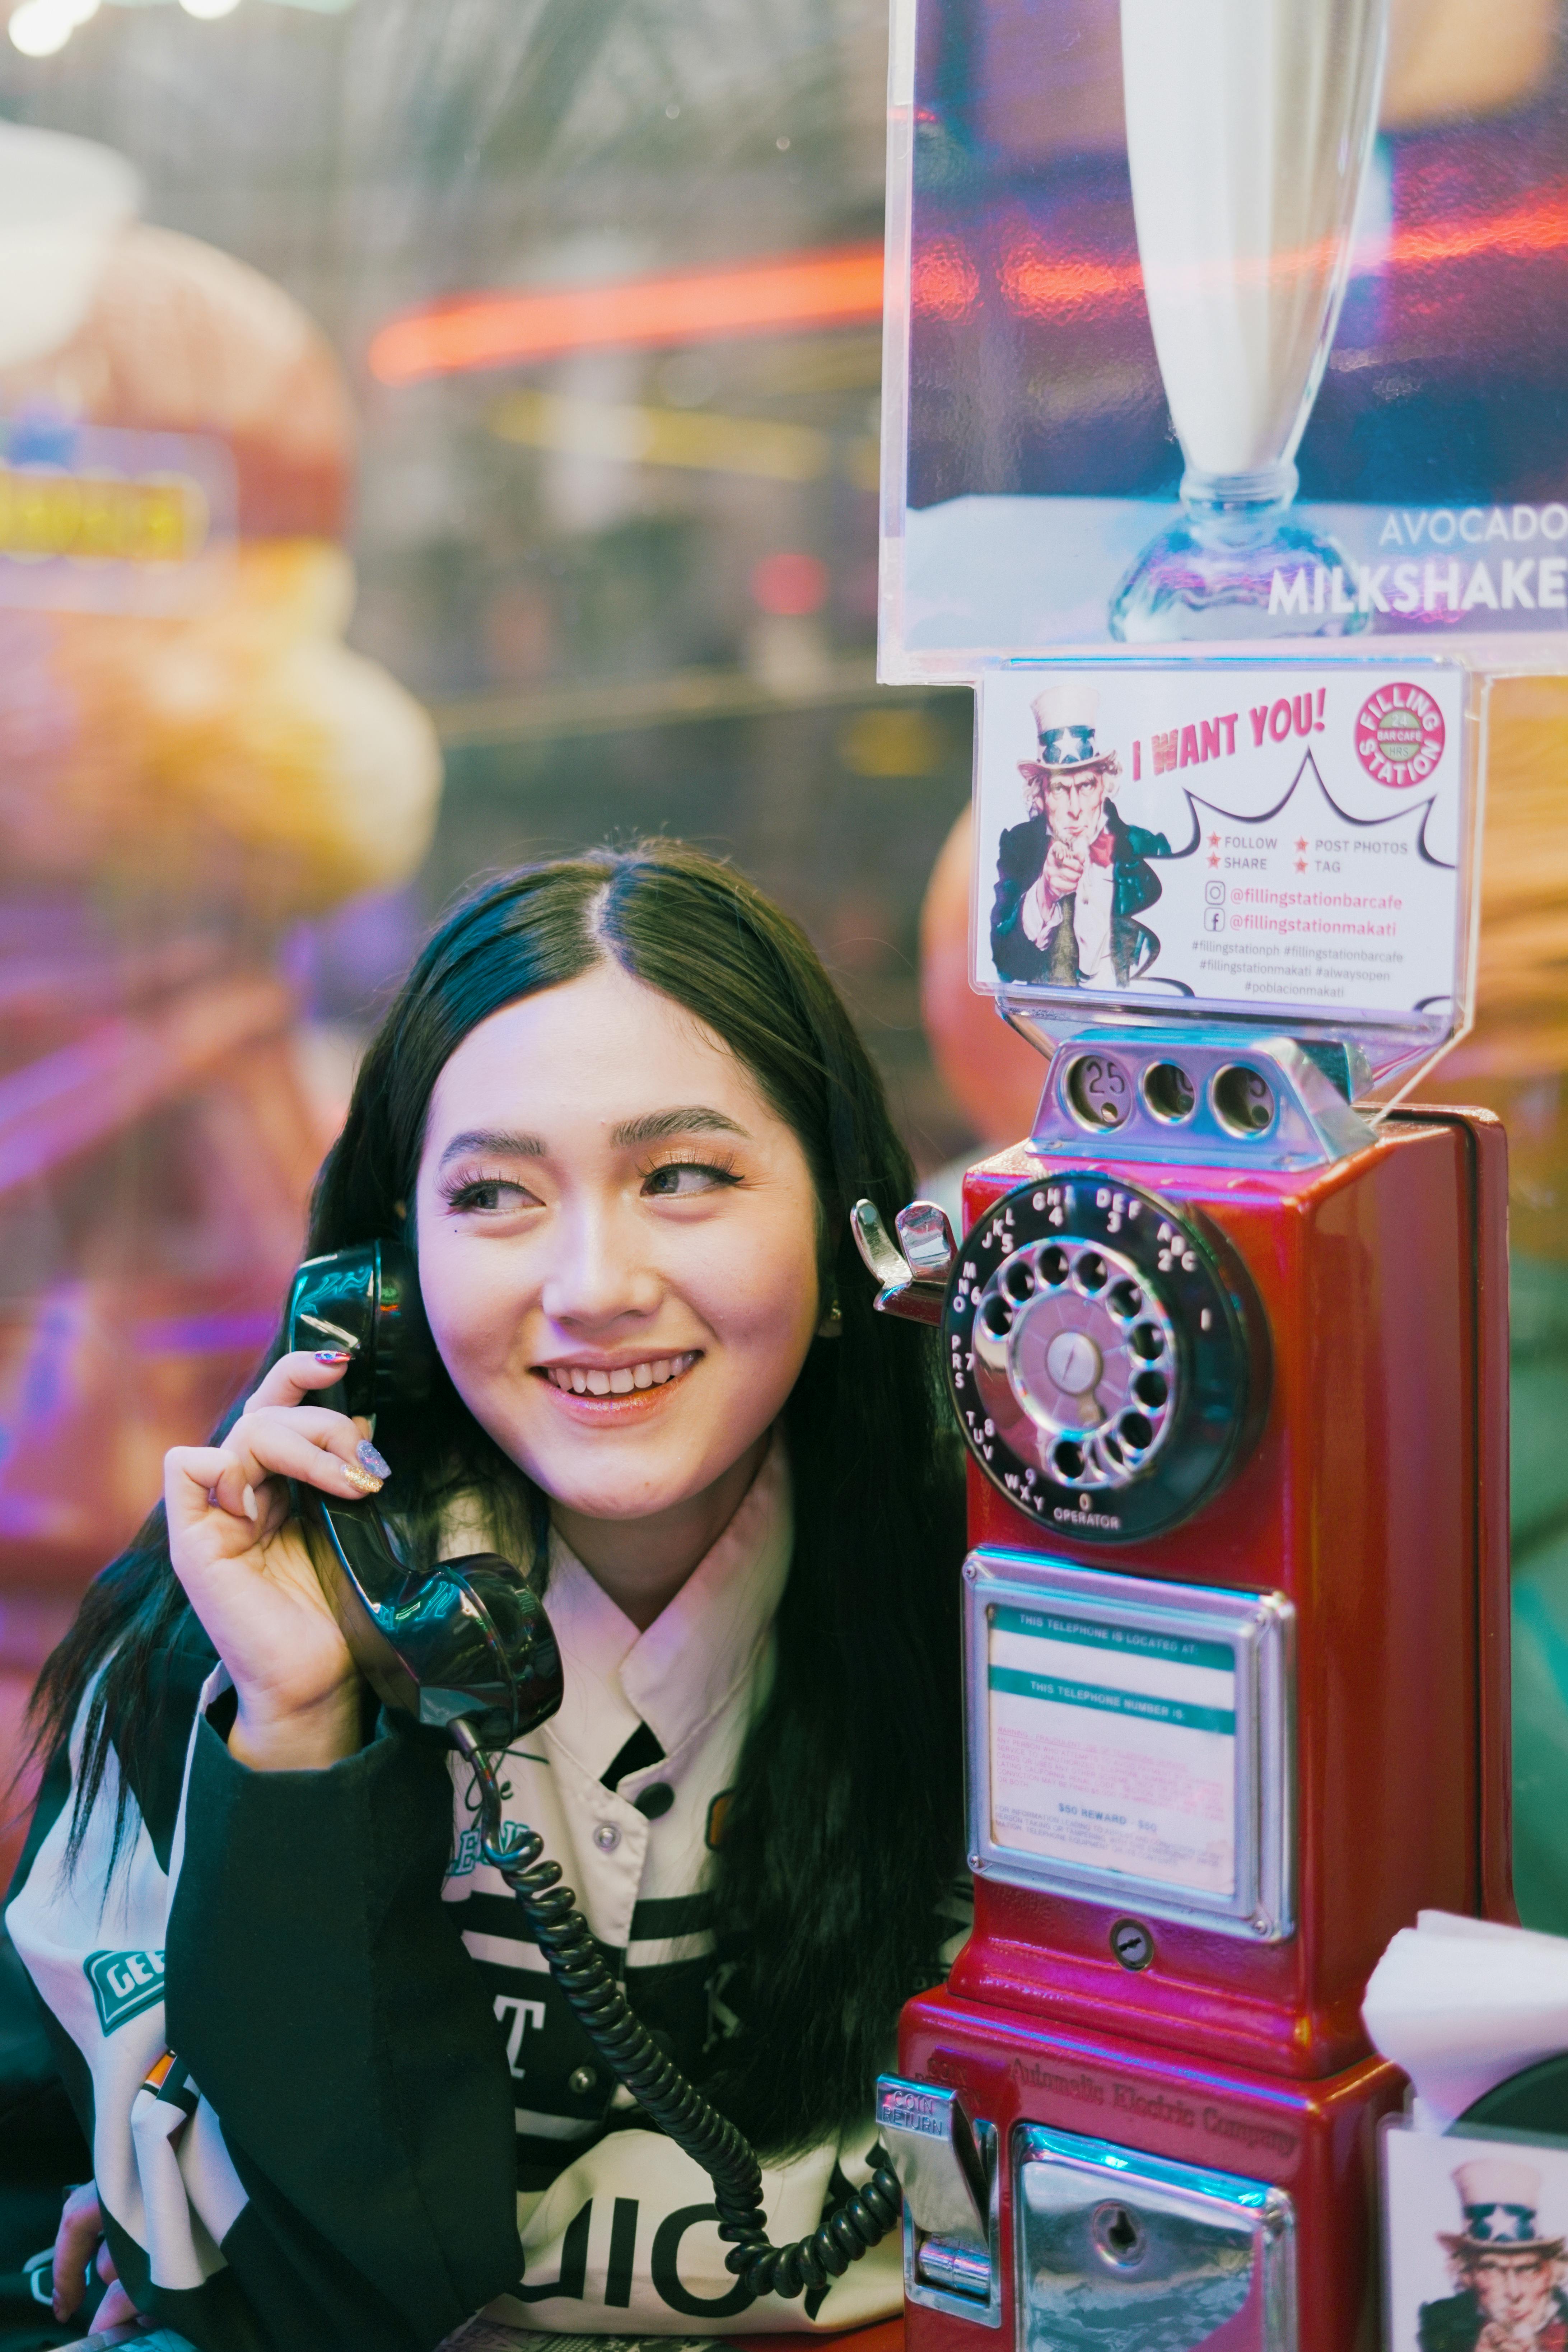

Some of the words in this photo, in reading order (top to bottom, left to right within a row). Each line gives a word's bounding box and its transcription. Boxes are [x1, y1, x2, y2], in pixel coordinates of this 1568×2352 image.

[1379, 503, 1568, 546] AVOCADO
[1267, 556, 1568, 615] MILKSHAKE
[1359, 686, 1440, 731] FILLING
[1391, 713, 1408, 727] 24
[1132, 739, 1141, 781] I
[1151, 712, 1238, 776] WANT
[1249, 686, 1326, 747] YOU!
[1377, 730, 1396, 742] BAR
[1359, 738, 1440, 785] STATION
[1389, 747, 1409, 757] HRS
[1224, 836, 1278, 850] FOLLOW
[1315, 839, 1349, 852] POST
[1353, 840, 1408, 855] PHOTOS
[1224, 857, 1267, 871] SHARE
[1316, 861, 1341, 873] TAG
[1230, 887, 1402, 911] @fillingstationbarcafe
[1230, 914, 1397, 937] @fillingstationmakati
[1192, 940, 1279, 957] #fillingstationph
[1284, 944, 1403, 963] #fillingstationbarcafe
[1200, 959, 1311, 978] #fillingstationmakati
[1316, 966, 1390, 983] #alwaysopen
[1245, 981, 1344, 998] #poblacionmakati
[1087, 1060, 1126, 1094] 25
[1049, 1205, 1063, 1227] 4
[1107, 1210, 1122, 1233] 3
[1001, 1233, 1014, 1254] 5
[1158, 1248, 1173, 1272] 2
[971, 1286, 982, 1306] 6
[965, 1352, 975, 1371] 7
[984, 1418, 995, 1437] 8
[1025, 1468, 1036, 1486] 9
[1053, 1507, 1120, 1531] OPERATOR
[1020, 1614, 1044, 1627] THIS
[1047, 1618, 1108, 1640] TELEPHONE
[1112, 1631, 1123, 1643] IS
[1126, 1633, 1179, 1652] LOCATED
[1030, 1680, 1055, 1694] THIS
[1058, 1685, 1121, 1708] TELEPHONE
[1124, 1698, 1169, 1717] NUMBER
[1081, 1808, 1126, 1825] REWARD
[893, 2090, 934, 2115] COIN
[1011, 2058, 1104, 2106] Automatic
[1113, 2082, 1195, 2128] Electric
[1203, 2106, 1299, 2158] Company
[882, 2104, 943, 2136] RETURN
